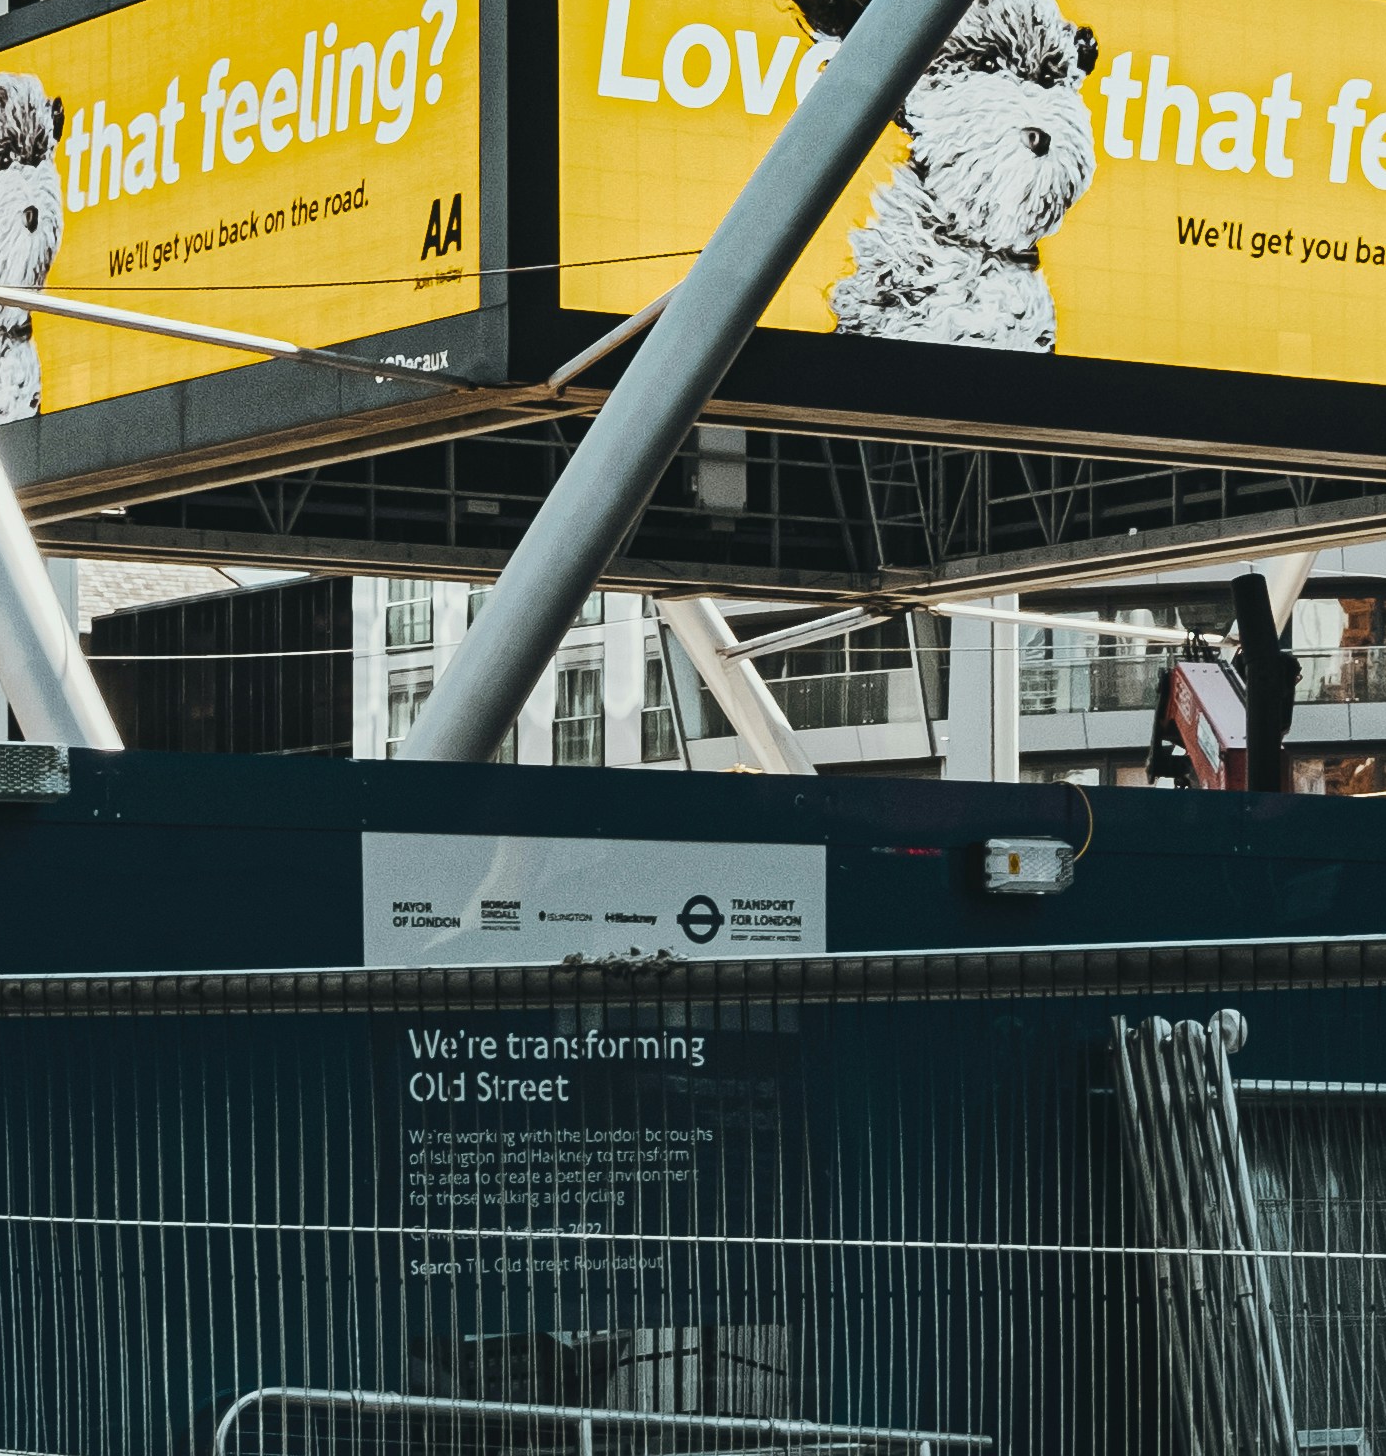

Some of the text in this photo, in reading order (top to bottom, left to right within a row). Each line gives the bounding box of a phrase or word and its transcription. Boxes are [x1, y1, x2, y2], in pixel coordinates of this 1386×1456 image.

[1100, 51, 1302, 178] that
[65, 76, 184, 212] that
[109, 179, 369, 277] We'll get you back on the road.
[421, 193, 461, 260] AA
[1176, 216, 1243, 250] We'll
[1250, 229, 1294, 259] get
[1300, 235, 1348, 264] you
[392, 902, 433, 913] MAYOR
[731, 899, 795, 911] TRANSPORT
[392, 916, 461, 928] OF LONDON
[731, 915, 802, 927] FOR LONDON
[408, 1028, 705, 1067] We're transforming
[409, 1071, 569, 1102] Old Street
[520, 1129, 552, 1143] with
[557, 1128, 581, 1142] the
[409, 1149, 426, 1164] of
[597, 1150, 613, 1162] to
[409, 1171, 434, 1185] the
[545, 1173, 552, 1183] a
